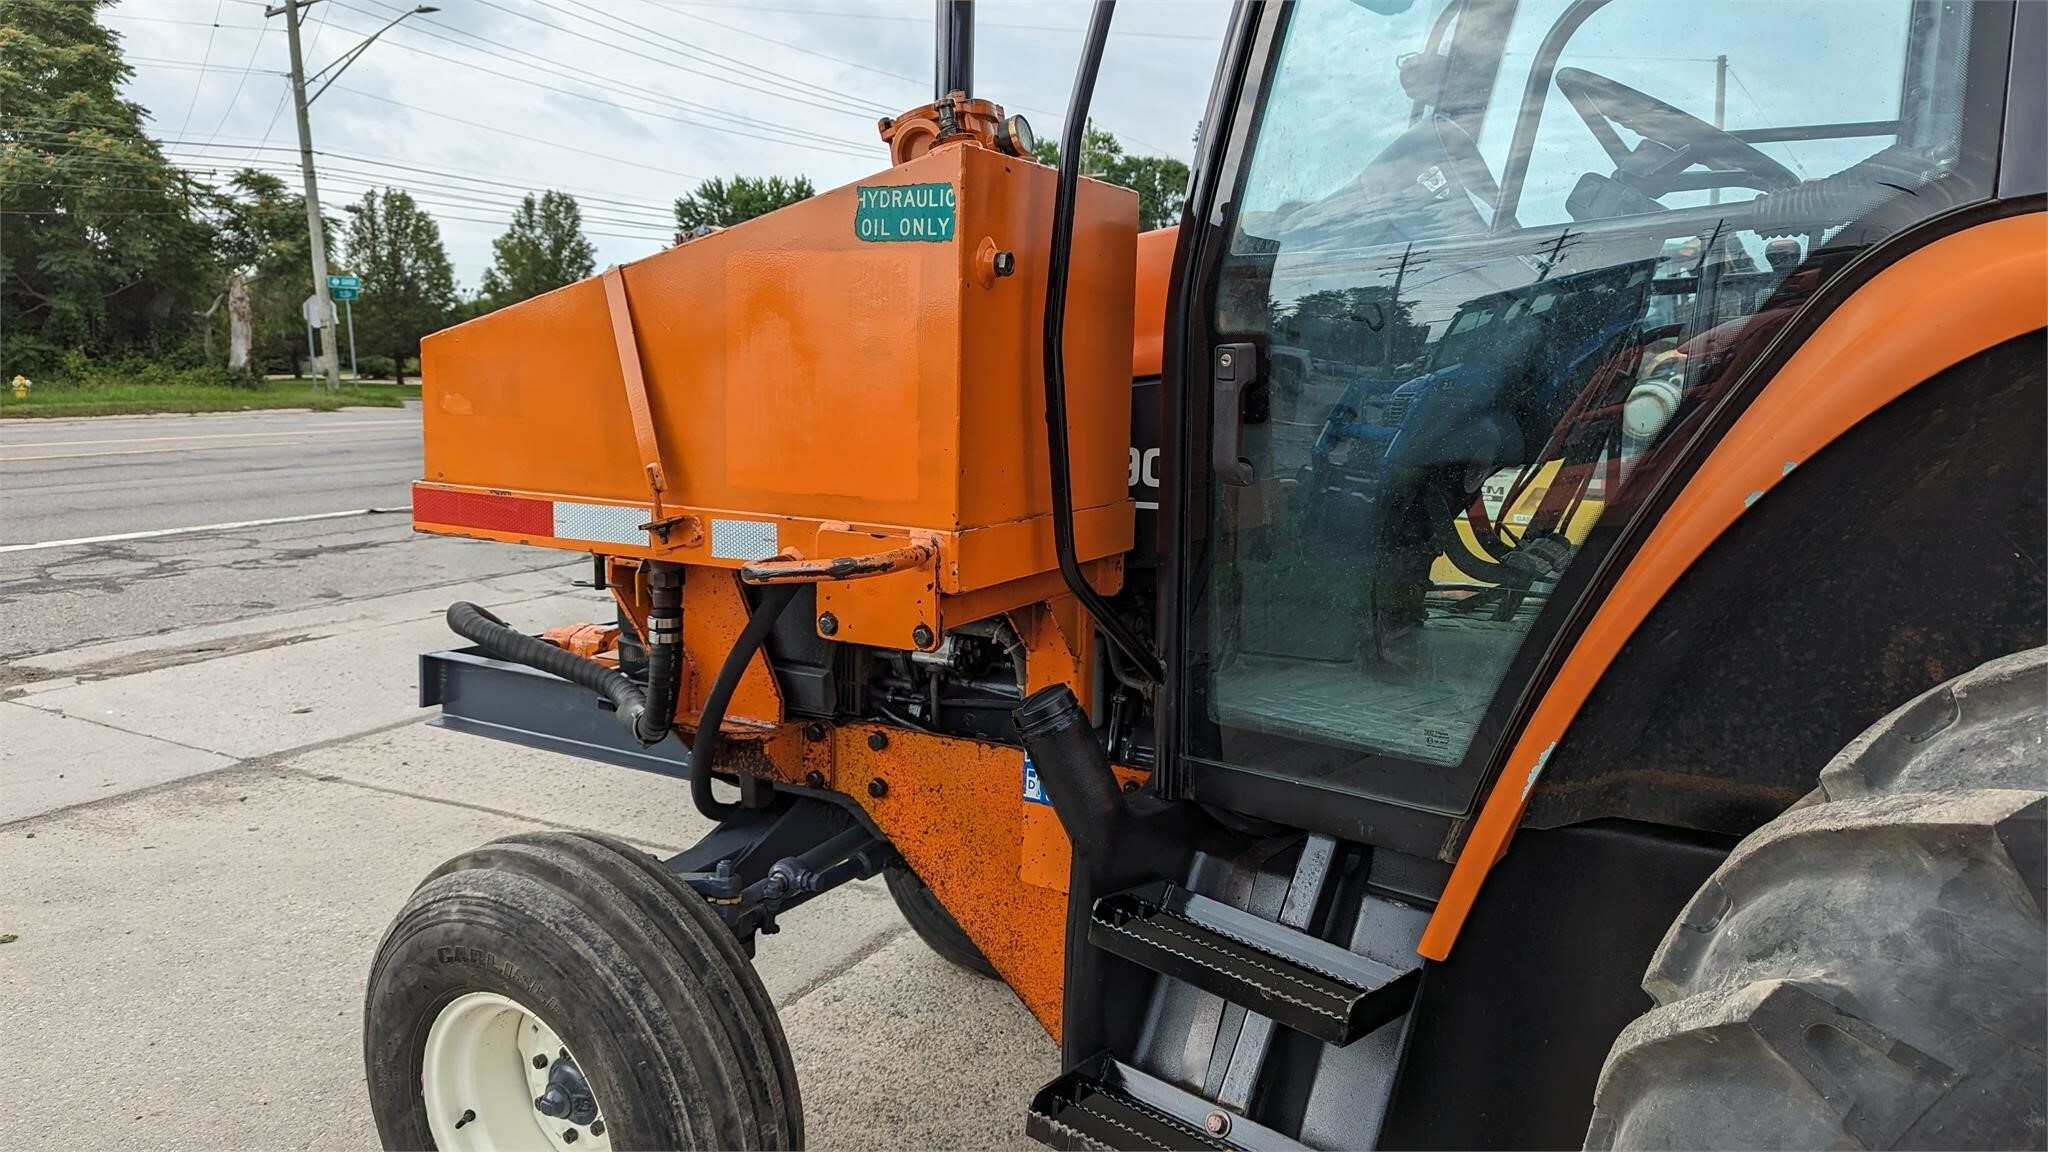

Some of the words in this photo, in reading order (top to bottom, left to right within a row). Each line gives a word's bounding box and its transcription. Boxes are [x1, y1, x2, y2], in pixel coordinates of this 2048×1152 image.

[860, 188, 955, 208] HYDRAULIC
[861, 218, 890, 236] OIL
[900, 217, 950, 236] ONLY
